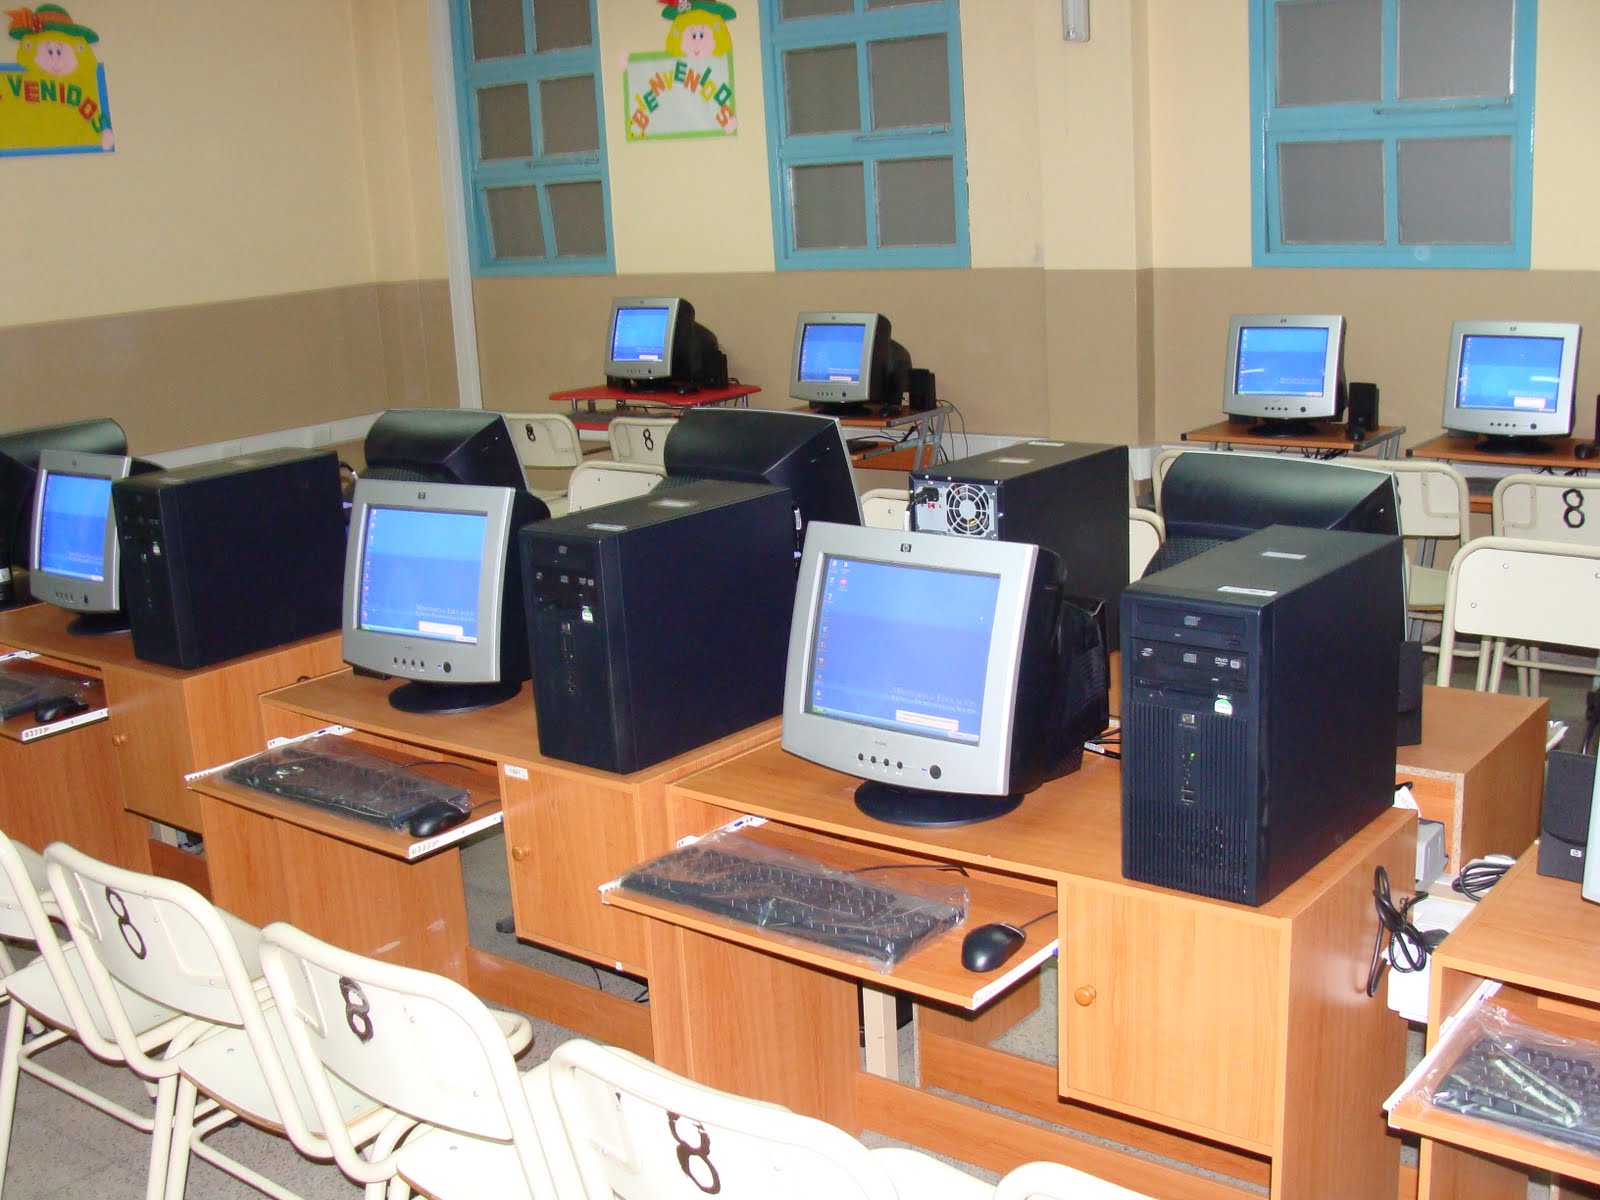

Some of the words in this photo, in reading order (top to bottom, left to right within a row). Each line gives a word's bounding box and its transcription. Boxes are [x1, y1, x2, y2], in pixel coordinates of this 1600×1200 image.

[0, 73, 112, 134] VENIDOS
[632, 60, 735, 131] BIENVENIDOS
[525, 423, 536, 442] 8
[643, 428, 654, 450] 8
[1562, 488, 1585, 528] 8
[105, 885, 147, 960] 8
[339, 976, 374, 1044] 8
[666, 1111, 721, 1195] 8
